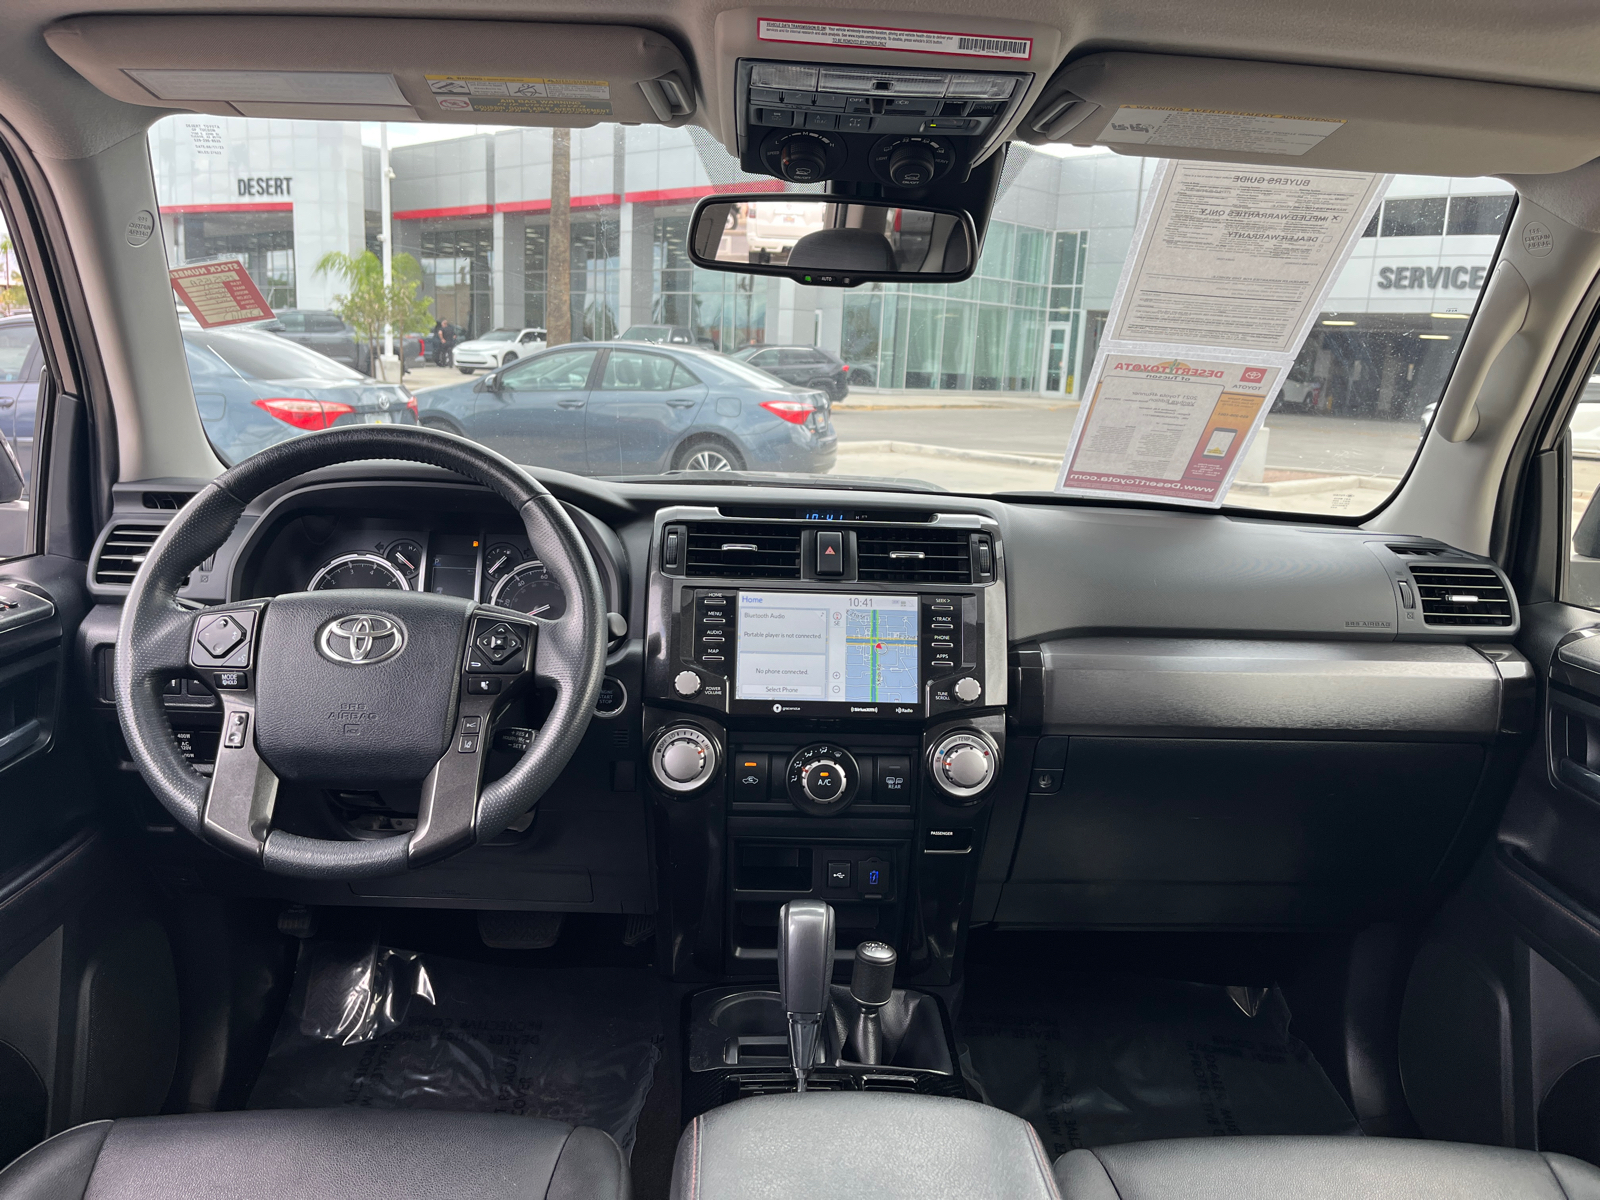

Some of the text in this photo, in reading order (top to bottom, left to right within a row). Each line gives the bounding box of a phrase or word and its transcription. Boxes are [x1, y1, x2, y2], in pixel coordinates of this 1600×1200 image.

[237, 177, 293, 196] DESERT
[1377, 265, 1487, 290] SERVICE
[741, 595, 763, 603] Home
[848, 597, 873, 607] 10:41
[328, 711, 379, 720] AIRBAG
[817, 778, 832, 786] A/C
